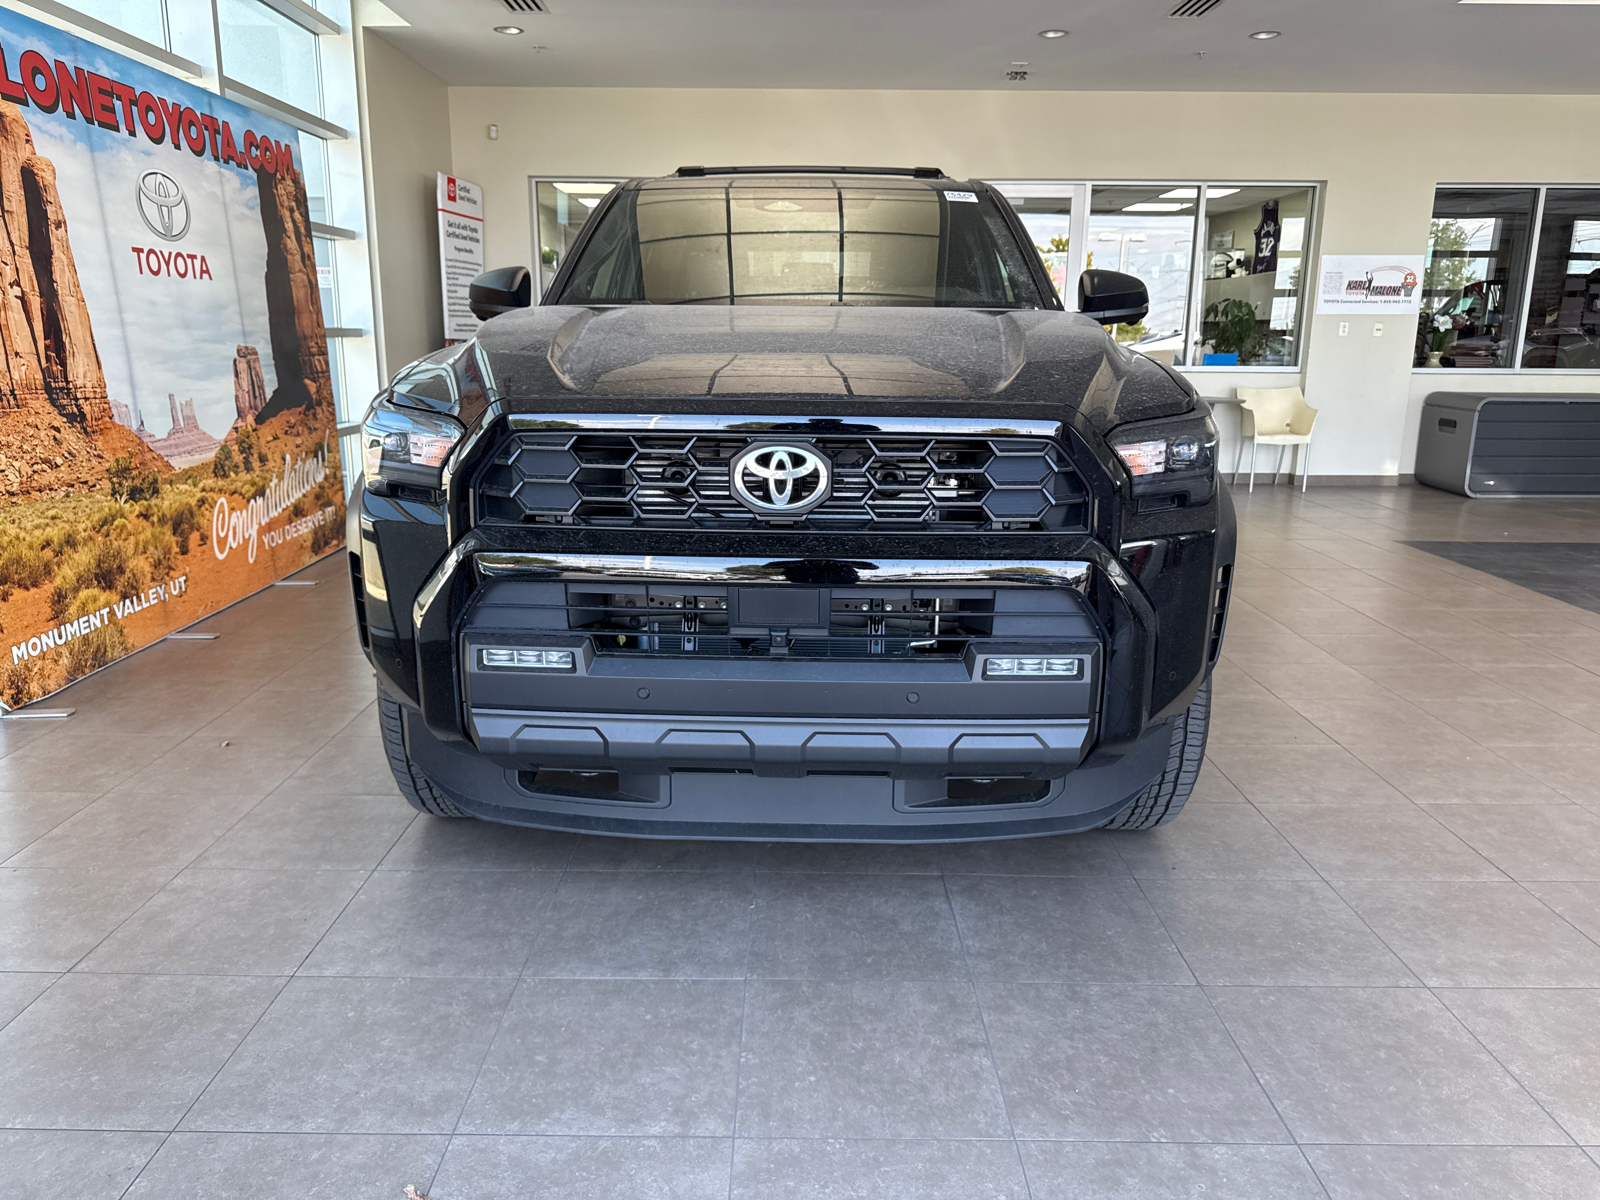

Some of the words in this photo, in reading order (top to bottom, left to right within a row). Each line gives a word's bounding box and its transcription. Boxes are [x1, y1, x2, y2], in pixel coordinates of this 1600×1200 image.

[131, 246, 213, 281] TOYOTA
[1258, 237, 1274, 257] 32
[1345, 280, 1367, 291] KARL
[1369, 286, 1402, 296] MALONE
[212, 428, 330, 563] Congratulations!
[262, 530, 283, 550] YOU
[285, 512, 325, 541] DESERVE
[324, 505, 336, 526] IT!
[11, 607, 110, 665] MONUMENT
[113, 584, 169, 620] VALLEY,
[170, 575, 187, 596] UT
